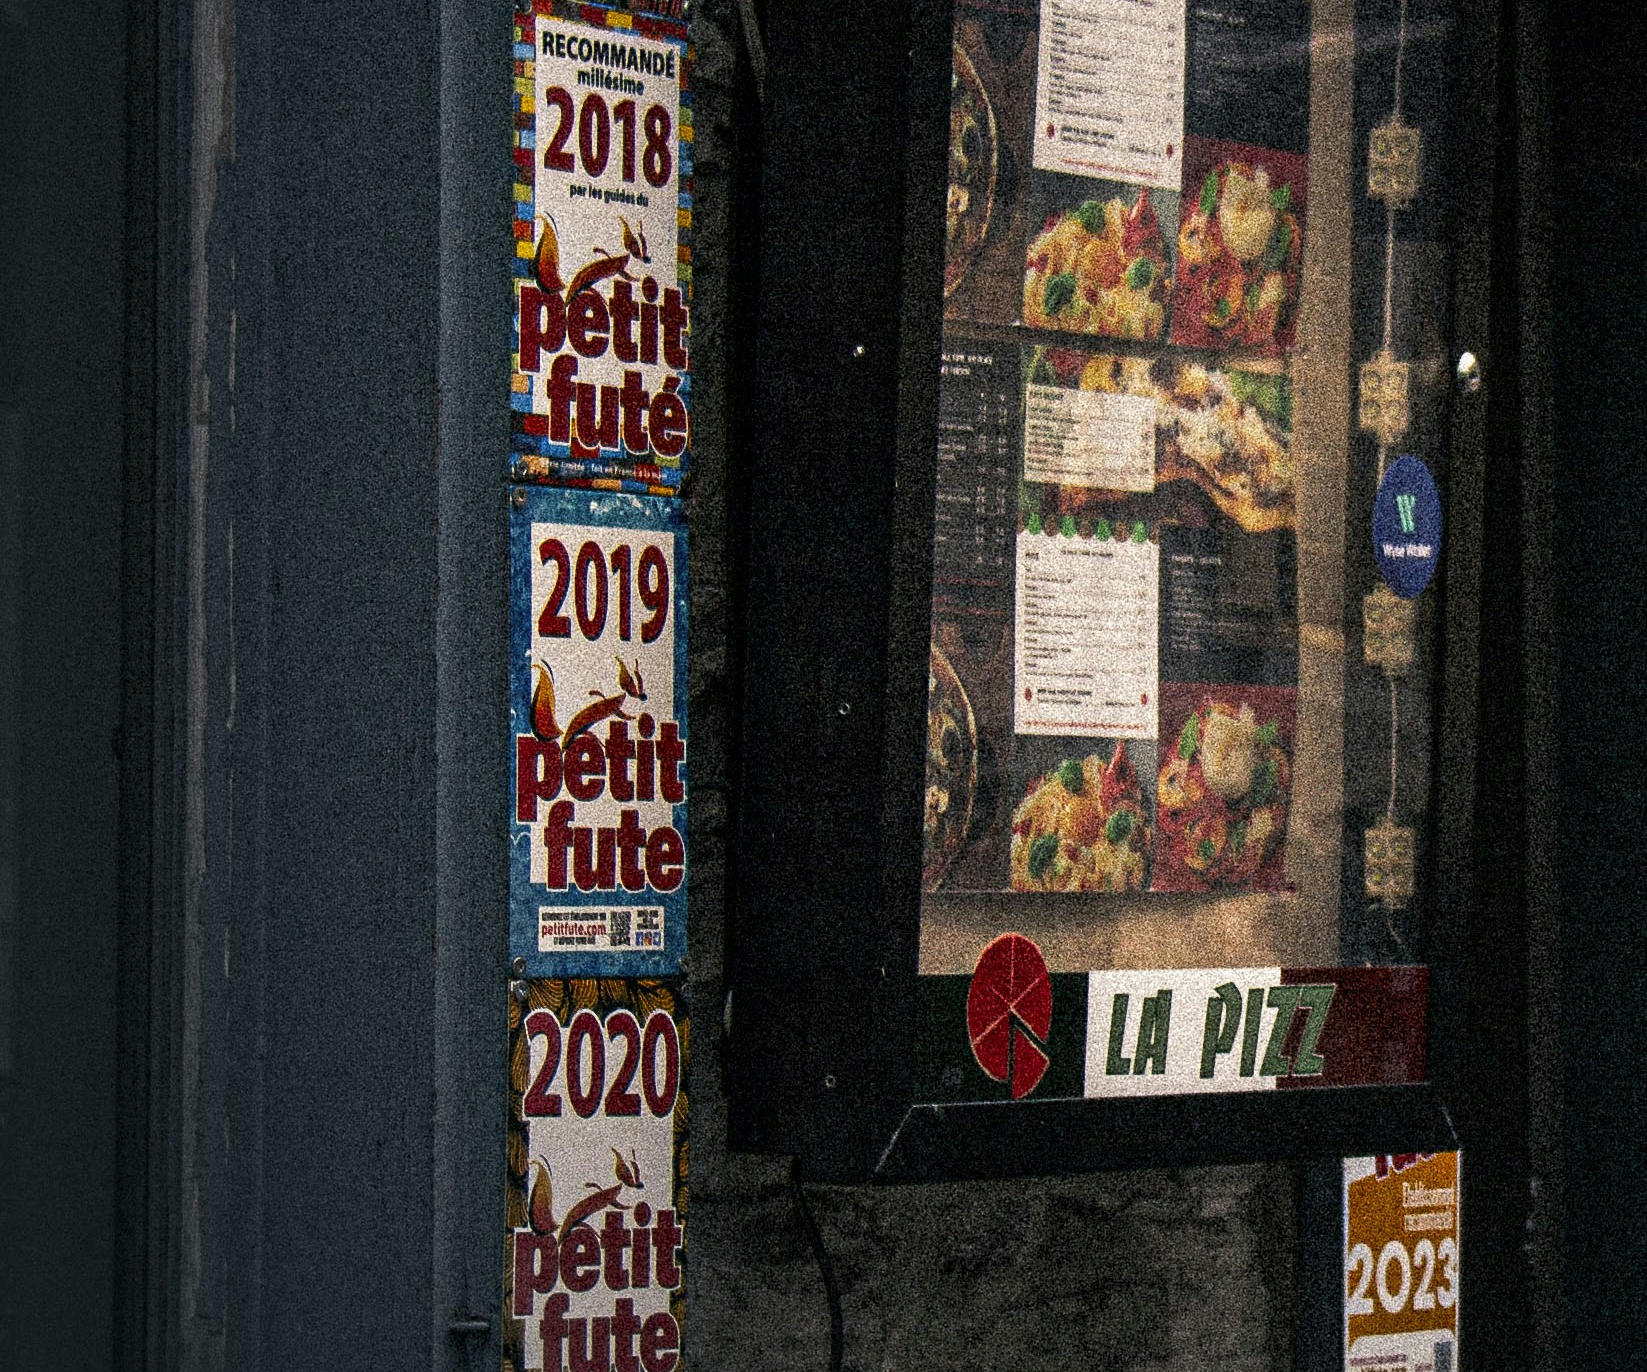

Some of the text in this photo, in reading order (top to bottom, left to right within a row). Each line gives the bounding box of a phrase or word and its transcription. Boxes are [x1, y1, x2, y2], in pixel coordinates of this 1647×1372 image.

[542, 30, 676, 79] RECOMMANDÉ
[578, 66, 645, 96] millésime
[544, 86, 672, 188] 2018
[570, 183, 649, 207] par les guides du
[519, 277, 688, 372] petit
[547, 354, 688, 457] futé
[538, 538, 670, 643] 2019
[517, 712, 686, 822] petit
[544, 800, 685, 891] fute
[541, 922, 607, 938] petitfute.com
[523, 1010, 680, 1119] 2020
[1106, 981, 1337, 1079] LA PIZZ
[514, 1201, 683, 1316] petit
[1346, 1238, 1458, 1315] 2023
